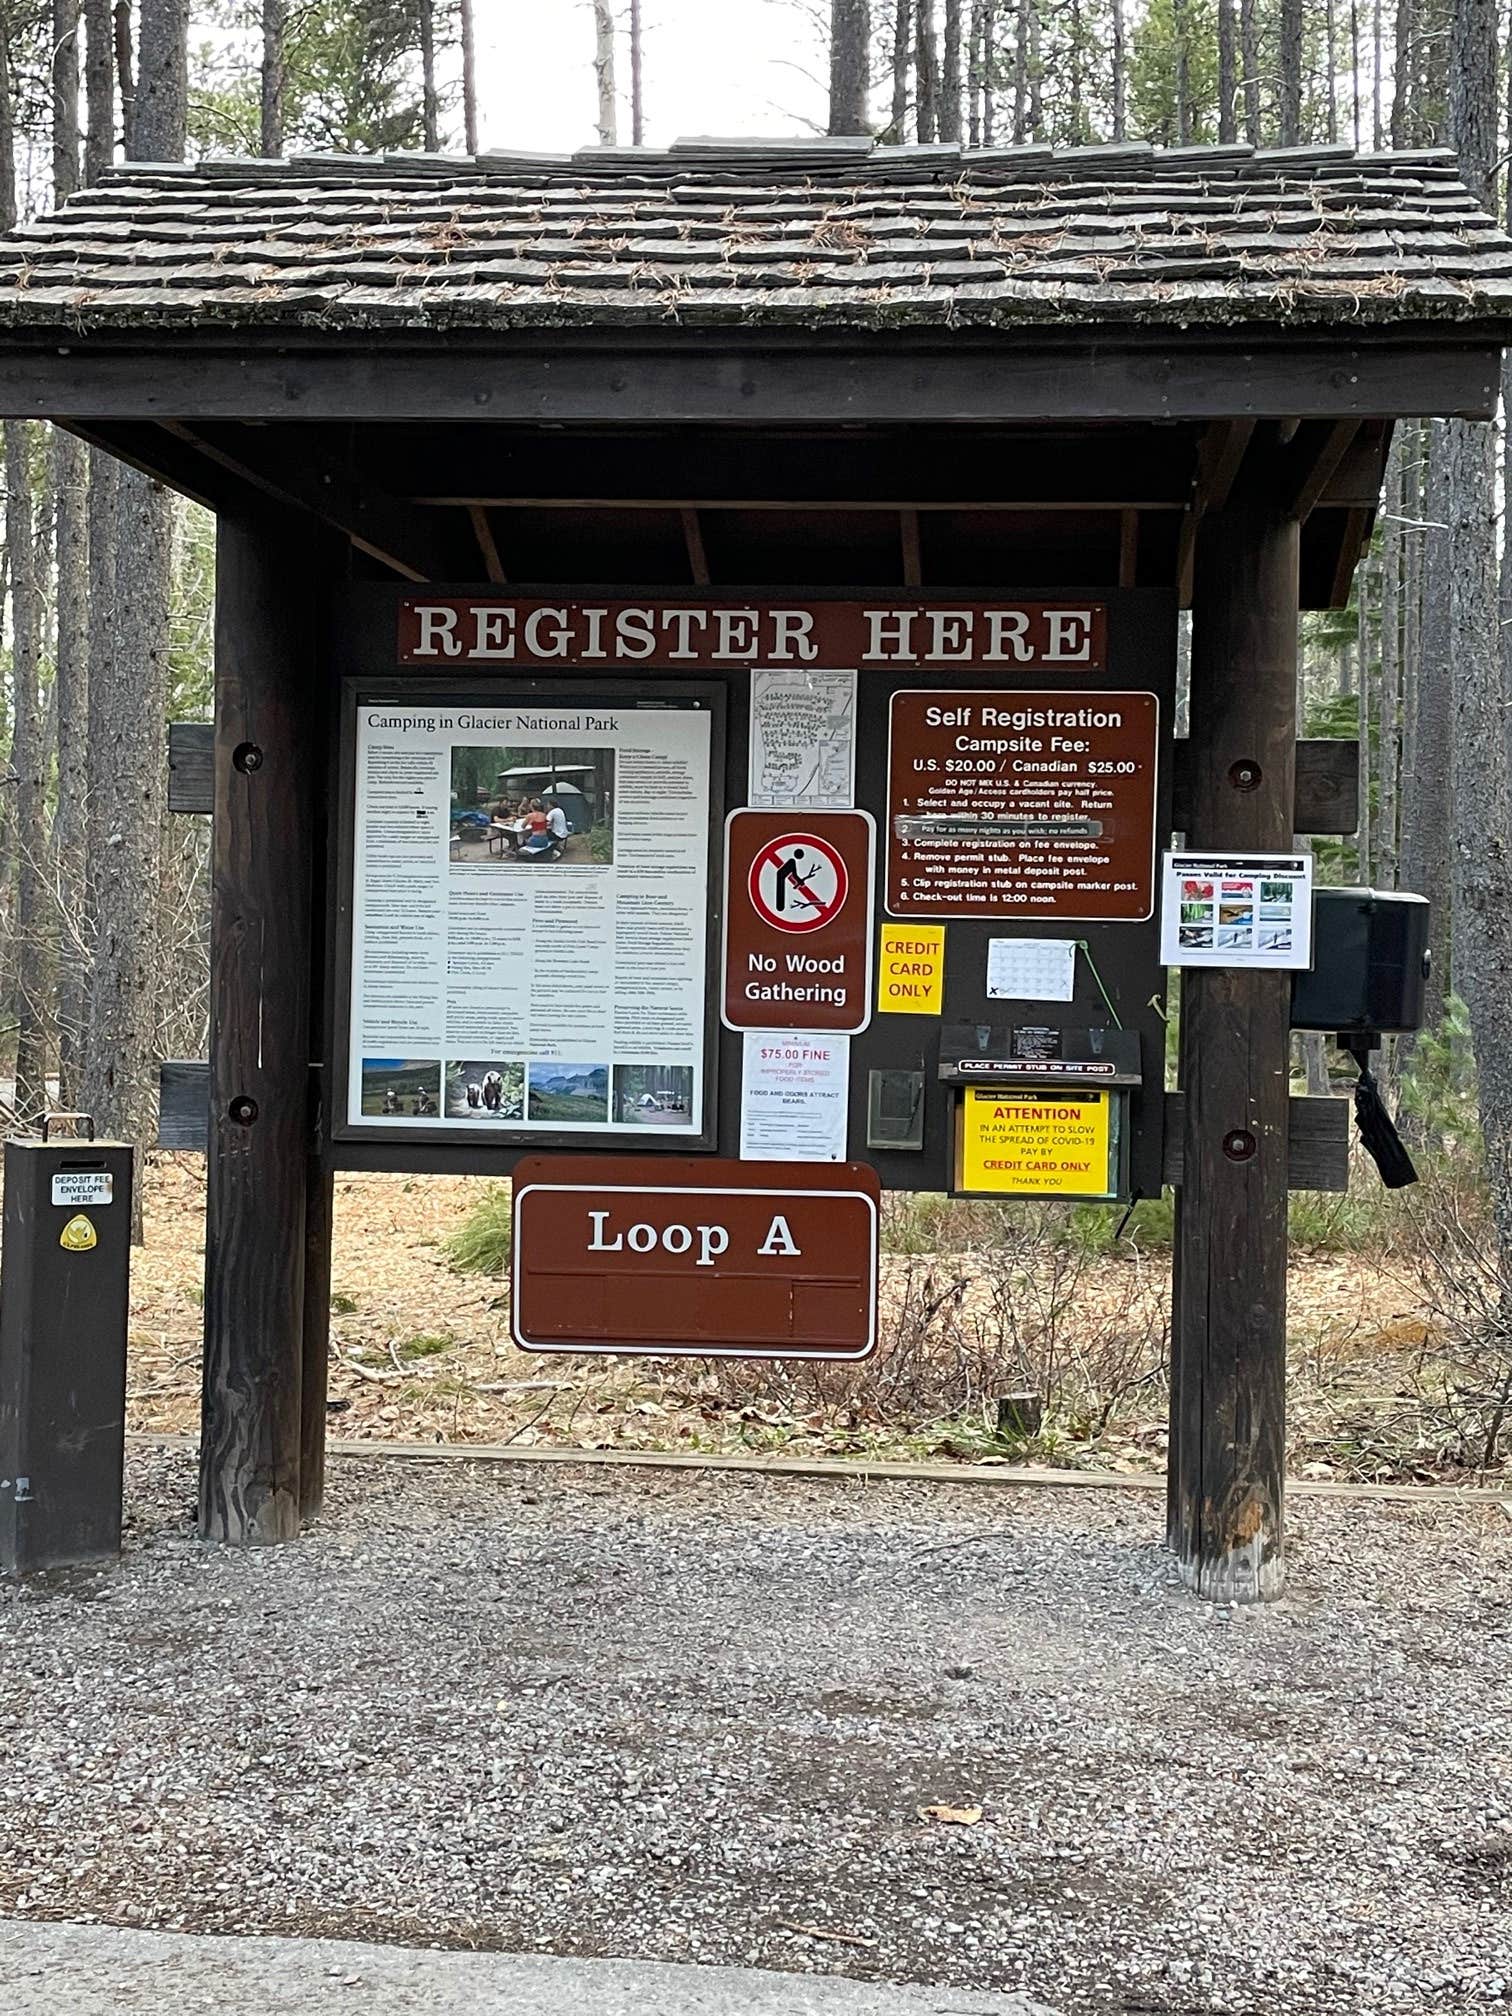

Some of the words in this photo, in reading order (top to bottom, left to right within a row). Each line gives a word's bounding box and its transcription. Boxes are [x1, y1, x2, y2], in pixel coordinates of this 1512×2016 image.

[413, 607, 819, 660] REGISTER
[862, 610, 1092, 662] HERE
[368, 714, 436, 732] Camping
[439, 715, 453, 729] in
[458, 715, 512, 730] Glacier
[516, 716, 580, 731] National
[585, 716, 619, 731] Park
[925, 707, 971, 727] Self
[981, 708, 1122, 730] Registration
[955, 736, 1043, 754] Campsite
[1051, 737, 1090, 752] Fee:
[913, 759, 941, 772] U.S.
[945, 759, 996, 773] $20.00
[999, 759, 1006, 773] /
[1012, 760, 1078, 773] Canadian
[1087, 761, 1135, 774] $25.00
[960, 779, 976, 787] NOT
[1023, 780, 1059, 788] Canadian
[1061, 781, 1098, 789] currency.
[928, 787, 956, 795] Golden
[958, 787, 1007, 796] Age/Access
[1009, 788, 1055, 796] cardholders
[1092, 789, 1114, 797] price.
[903, 798, 910, 807] 1.
[917, 798, 947, 807] Select
[950, 799, 968, 807] and
[971, 800, 1006, 809] occupy
[1019, 800, 1050, 808] vacant
[1053, 800, 1074, 808] site.
[1081, 800, 1113, 809] Return
[981, 812, 994, 820] 30
[997, 812, 1034, 820] minutes
[1051, 813, 1091, 822] register.
[921, 825, 935, 834] Pay
[957, 827, 978, 835] many
[979, 827, 1001, 835] nights
[1012, 828, 1026, 836] you
[901, 838, 911, 847] 3.
[914, 839, 959, 848] Complete
[961, 840, 1015, 849] registration
[1034, 840, 1050, 848] fee
[1053, 841, 1099, 850] envelope.
[901, 852, 911, 860] 4.
[914, 852, 951, 860] Remove
[954, 853, 984, 862] permit
[988, 853, 1011, 861] stub.
[1018, 854, 1044, 862] Place
[1048, 855, 1063, 863] fee
[1067, 855, 1110, 864] envelope
[925, 865, 945, 873] with
[948, 866, 979, 875] money
[994, 866, 1021, 874] metal
[1024, 867, 1060, 876] deposit
[1063, 868, 1087, 876] post.
[900, 878, 910, 887] 5.
[913, 878, 931, 888] Clip
[934, 879, 988, 888] registration
[991, 880, 1012, 888] stub
[1031, 880, 1074, 890] campsite
[1077, 882, 1111, 890] marker
[1114, 883, 1138, 891] post.
[900, 892, 910, 900] 6.
[913, 892, 962, 901] Check-out
[966, 893, 986, 901] time
[1002, 894, 1027, 902] 12:00
[1030, 895, 1056, 903] noon.
[885, 941, 940, 955] CREDIT
[748, 954, 777, 972] No
[786, 954, 845, 973] Wood
[890, 962, 933, 976] CARD
[745, 982, 846, 1007] Gathering
[889, 983, 932, 997] ONLY
[761, 1048, 799, 1059] $75.00
[802, 1050, 831, 1060] FINE
[964, 1062, 990, 1070] PLACE
[993, 1063, 1022, 1071] PERMIT
[993, 1107, 1081, 1120] ATTENTION
[1009, 1125, 1049, 1133] ATTEMPT
[1067, 1126, 1095, 1134] SLOW
[980, 1135, 996, 1143] THE
[999, 1136, 1034, 1144] SPREAD
[1037, 1136, 1049, 1144] OF
[1052, 1137, 1095, 1145] COVID-19
[984, 1160, 1023, 1169] CREDIT
[1026, 1161, 1058, 1170] CARD
[1060, 1162, 1091, 1171] ONLY
[55, 1176, 91, 1184] DEPOSIT
[94, 1176, 110, 1184] FEE
[1012, 1177, 1040, 1185] THANK
[60, 1185, 104, 1193] ENVELOPE
[71, 1195, 93, 1203] HERE
[587, 1211, 730, 1266] Loop
[757, 1216, 801, 1256] A
